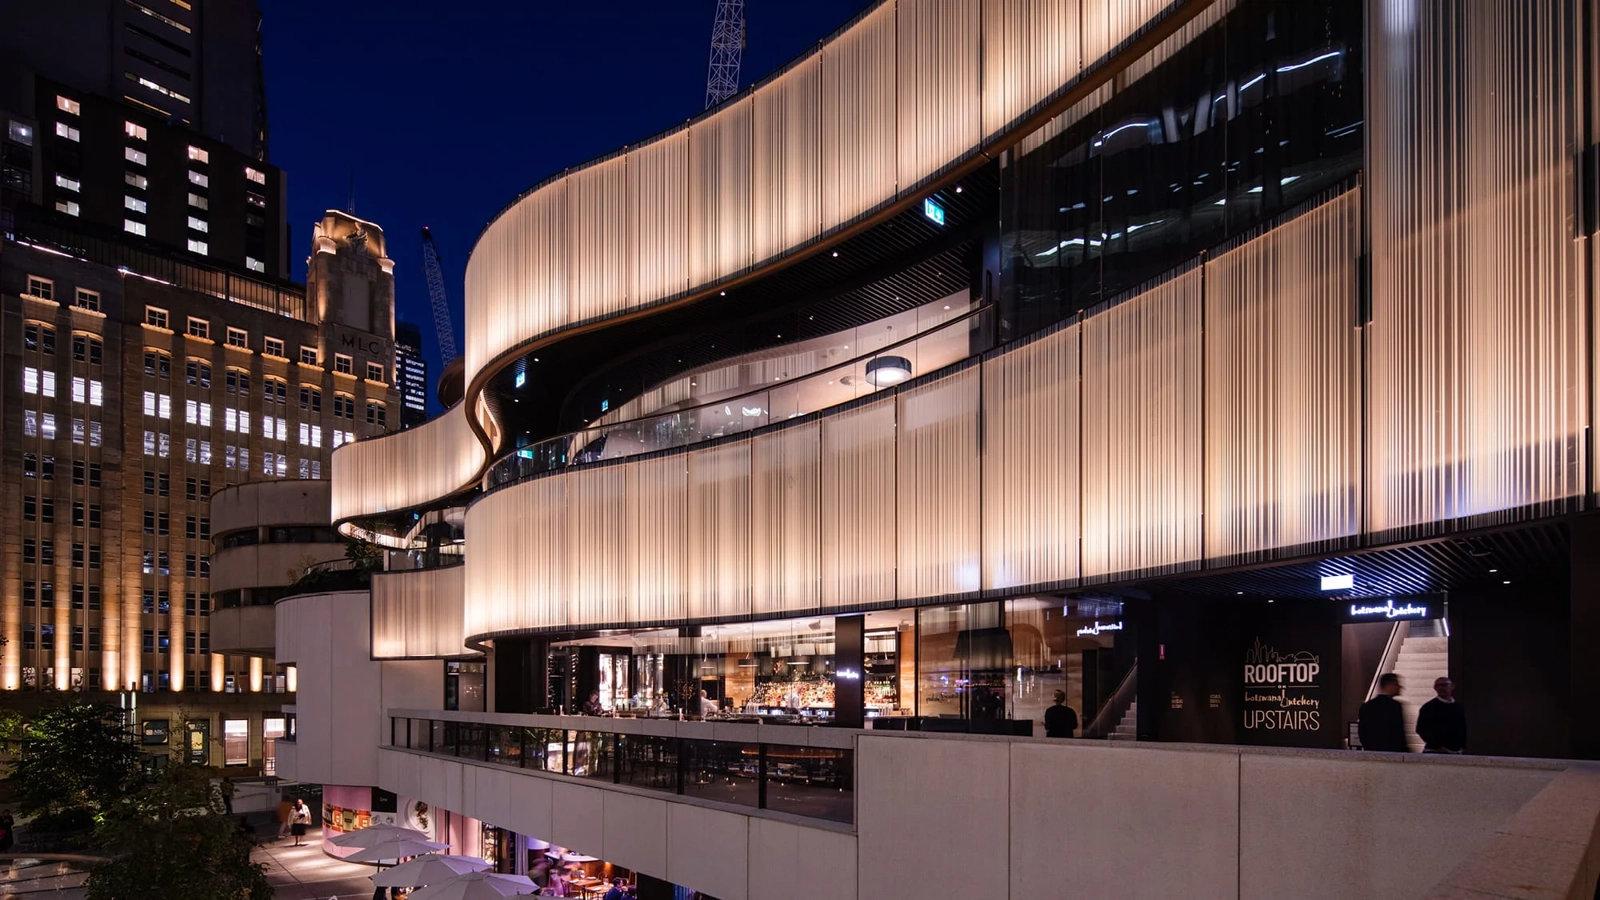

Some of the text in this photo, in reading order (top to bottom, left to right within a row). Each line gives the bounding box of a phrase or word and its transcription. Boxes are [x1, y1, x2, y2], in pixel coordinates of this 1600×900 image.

[342, 333, 380, 355] MLC
[1244, 662, 1320, 684] ROOFTOP
[1244, 709, 1321, 731] UPSTAIRS
